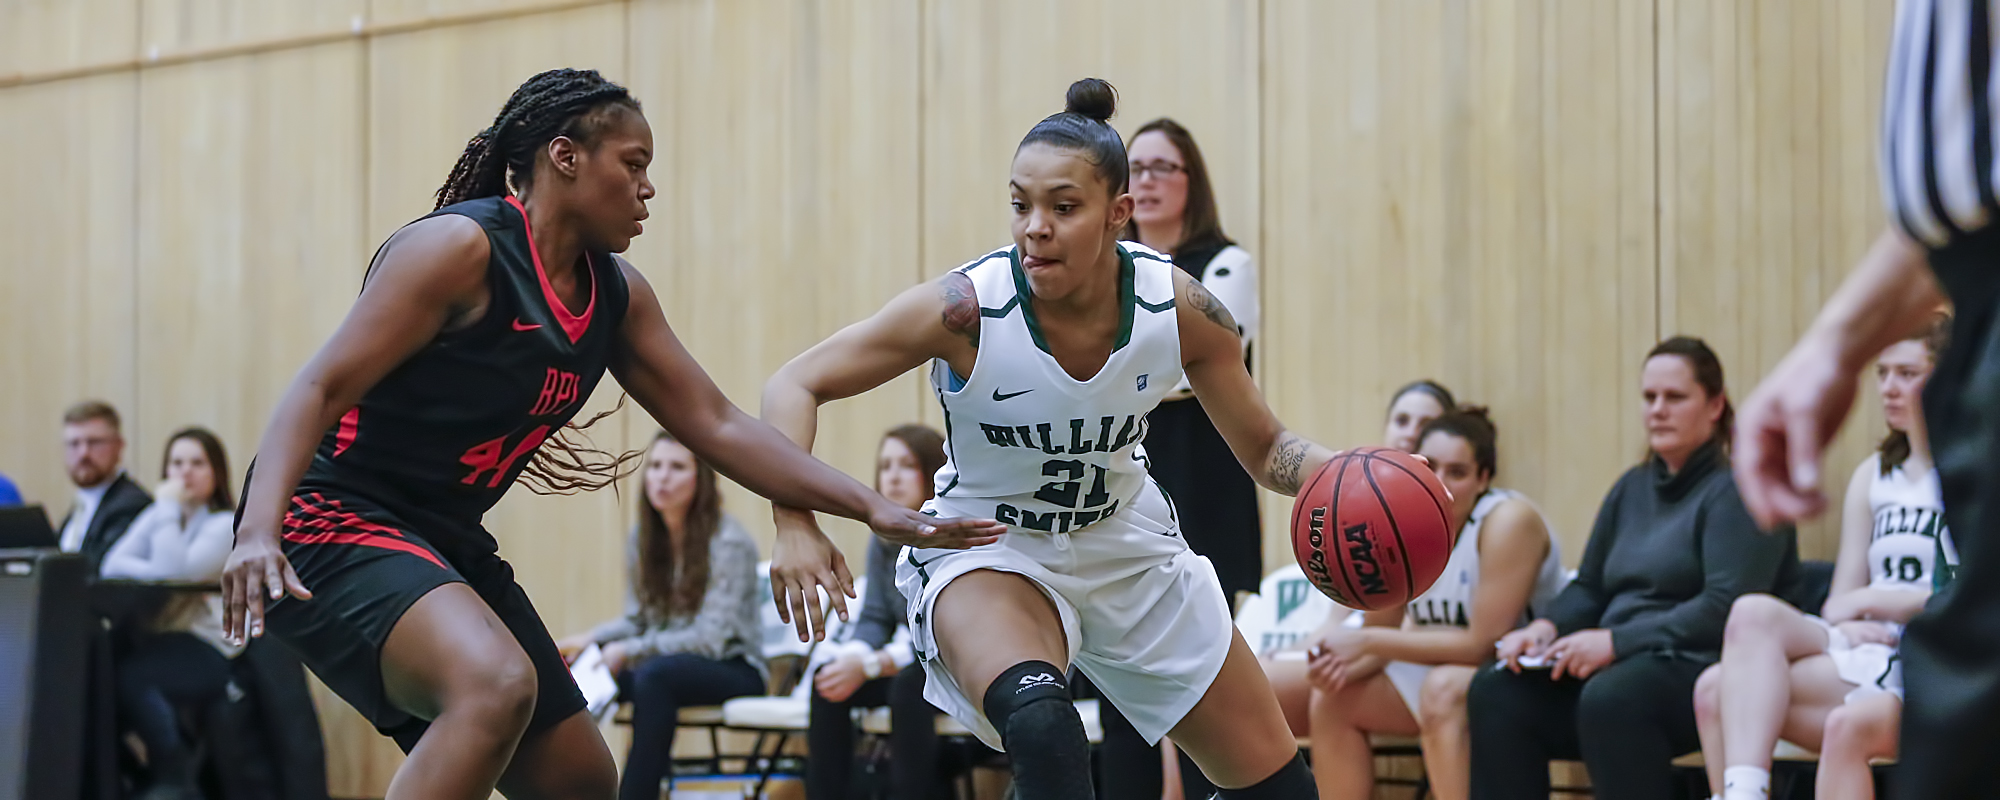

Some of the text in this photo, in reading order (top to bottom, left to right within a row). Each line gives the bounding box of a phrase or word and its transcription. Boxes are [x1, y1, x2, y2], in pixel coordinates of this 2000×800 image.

[1033, 459, 1110, 508] 21
[1871, 507, 1938, 539] ILLIA
[1344, 522, 1389, 595] NCAA
